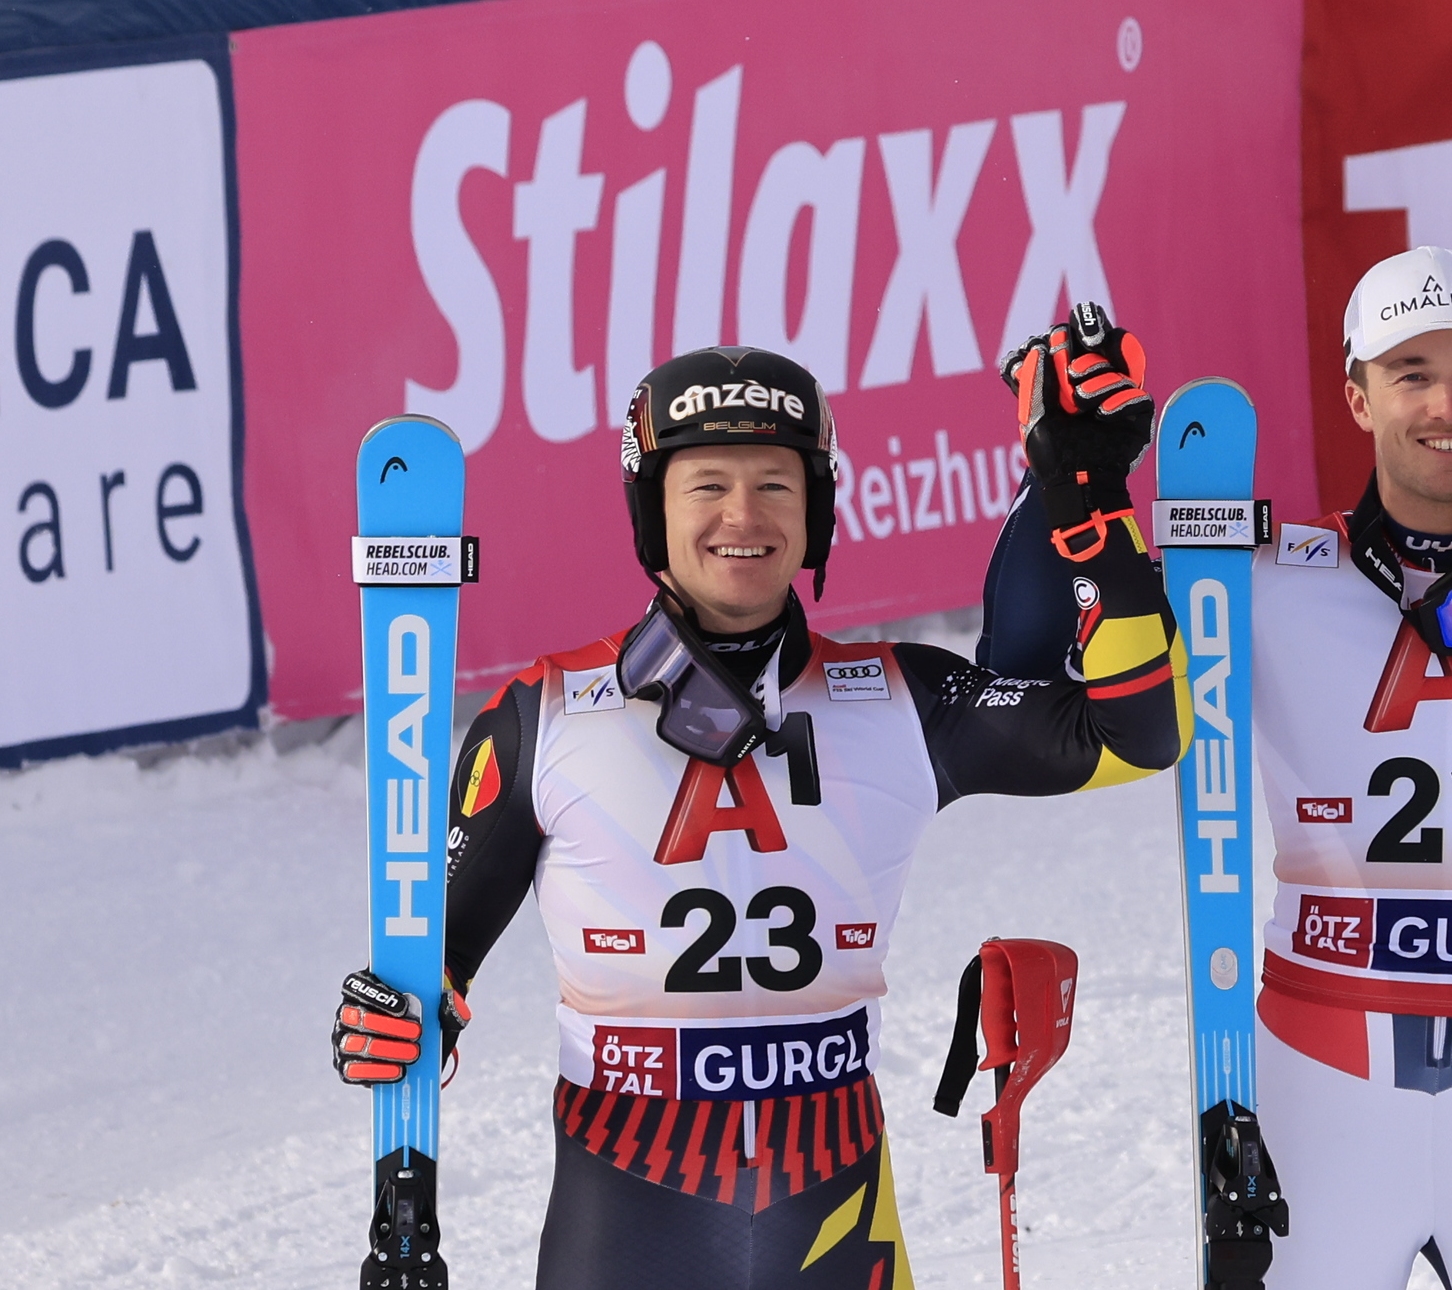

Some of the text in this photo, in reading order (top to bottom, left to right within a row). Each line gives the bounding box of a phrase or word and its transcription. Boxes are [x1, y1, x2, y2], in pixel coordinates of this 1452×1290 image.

[404, 39, 1128, 457] Stilaxx
[703, 420, 777, 432] BELGIUM
[1169, 506, 1248, 524] REBELSCLUB.
[1170, 522, 1227, 539] HEAD.COM
[365, 544, 451, 560] REBELSCLUB.
[466, 542, 476, 578] HEAD
[366, 561, 428, 577] HEAD.COM
[1365, 547, 1403, 592] HEA
[989, 676, 1053, 690] Magic
[975, 687, 1024, 708] Pass
[1189, 578, 1241, 894] HEAD
[385, 613, 431, 938] HEAD
[1301, 802, 1345, 820] Tirol
[1305, 905, 1362, 939] ÖTZ
[589, 932, 638, 951] Tirol
[660, 885, 823, 993] 23
[841, 927, 873, 946] Tirol
[345, 975, 399, 1009] reusch
[602, 1035, 664, 1069] ÖTZ
[694, 1029, 863, 1093] GURGL
[603, 1072, 663, 1097] TAL
[1246, 1174, 1258, 1199] 14X
[399, 1235, 412, 1260] 14X
